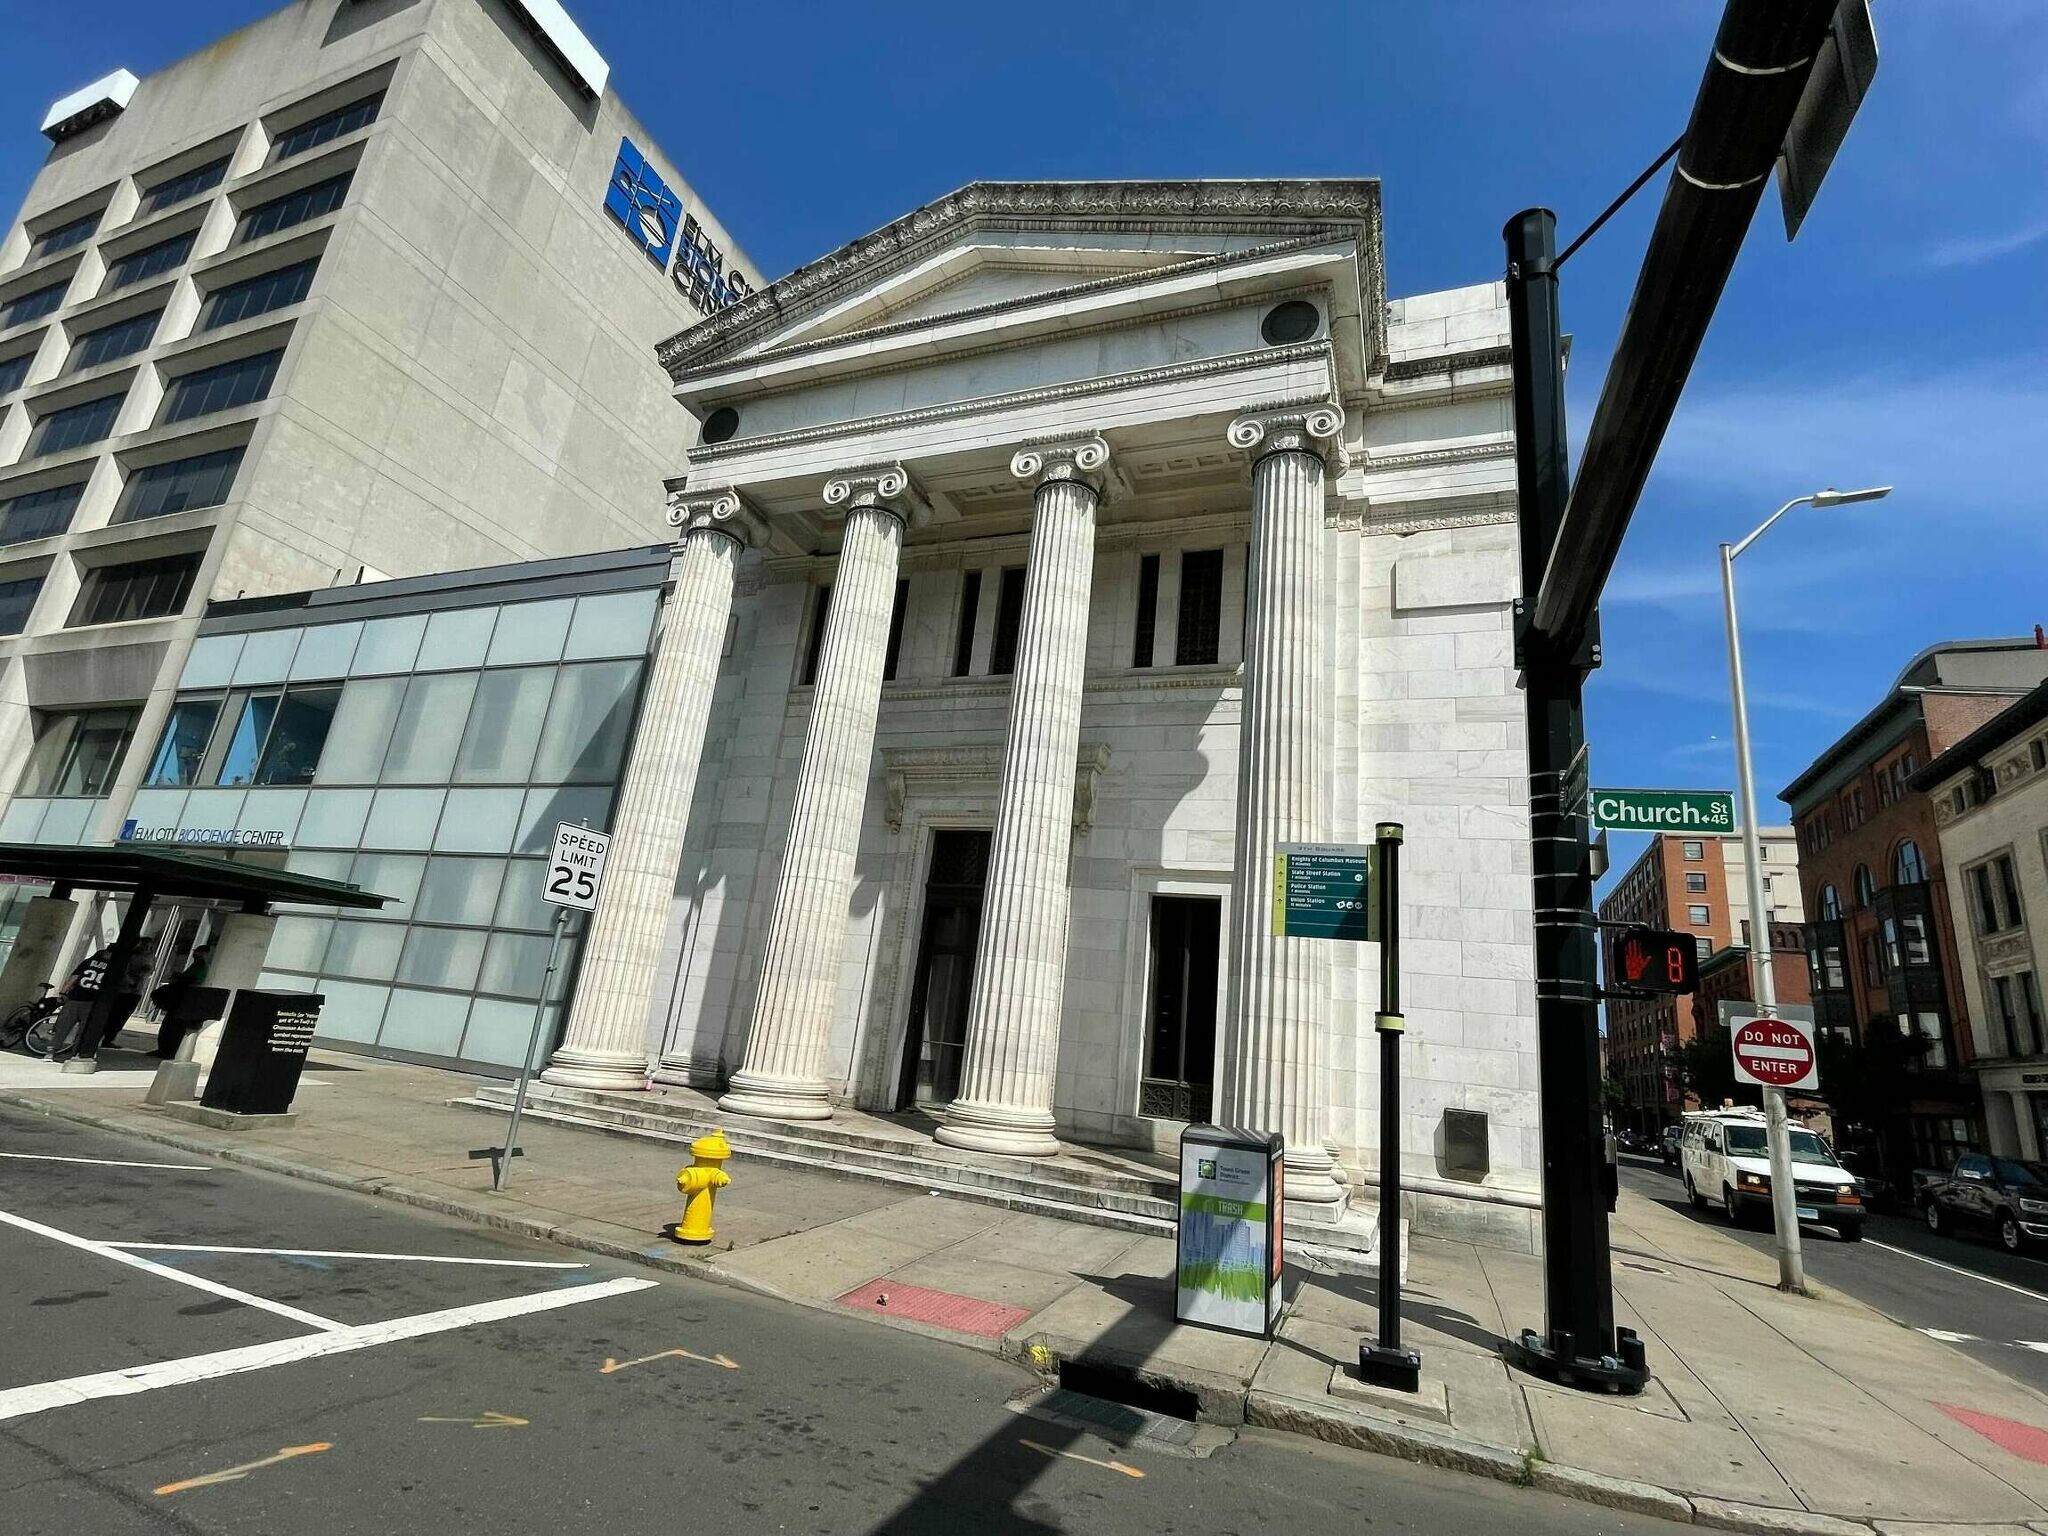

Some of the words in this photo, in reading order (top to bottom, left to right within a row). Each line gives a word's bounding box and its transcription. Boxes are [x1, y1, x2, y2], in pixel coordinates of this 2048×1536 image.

[684, 212, 723, 274] ELM
[1598, 798, 1700, 824] Church
[1711, 801, 1728, 814] St
[1710, 814, 1729, 825] 45
[135, 827, 154, 841] ELM
[155, 827, 178, 842] CITY
[177, 828, 242, 845] BIOSCIENCE
[242, 830, 284, 846] CENTER
[559, 832, 605, 854] SPEED
[560, 849, 597, 869] LIMIT
[549, 865, 596, 900] 25
[1667, 947, 1683, 983] 8
[1744, 1030, 1764, 1042] DO
[1771, 1032, 1800, 1045] NOT
[1752, 1060, 1798, 1074] ENTER
[1218, 1200, 1243, 1215] TRASH
